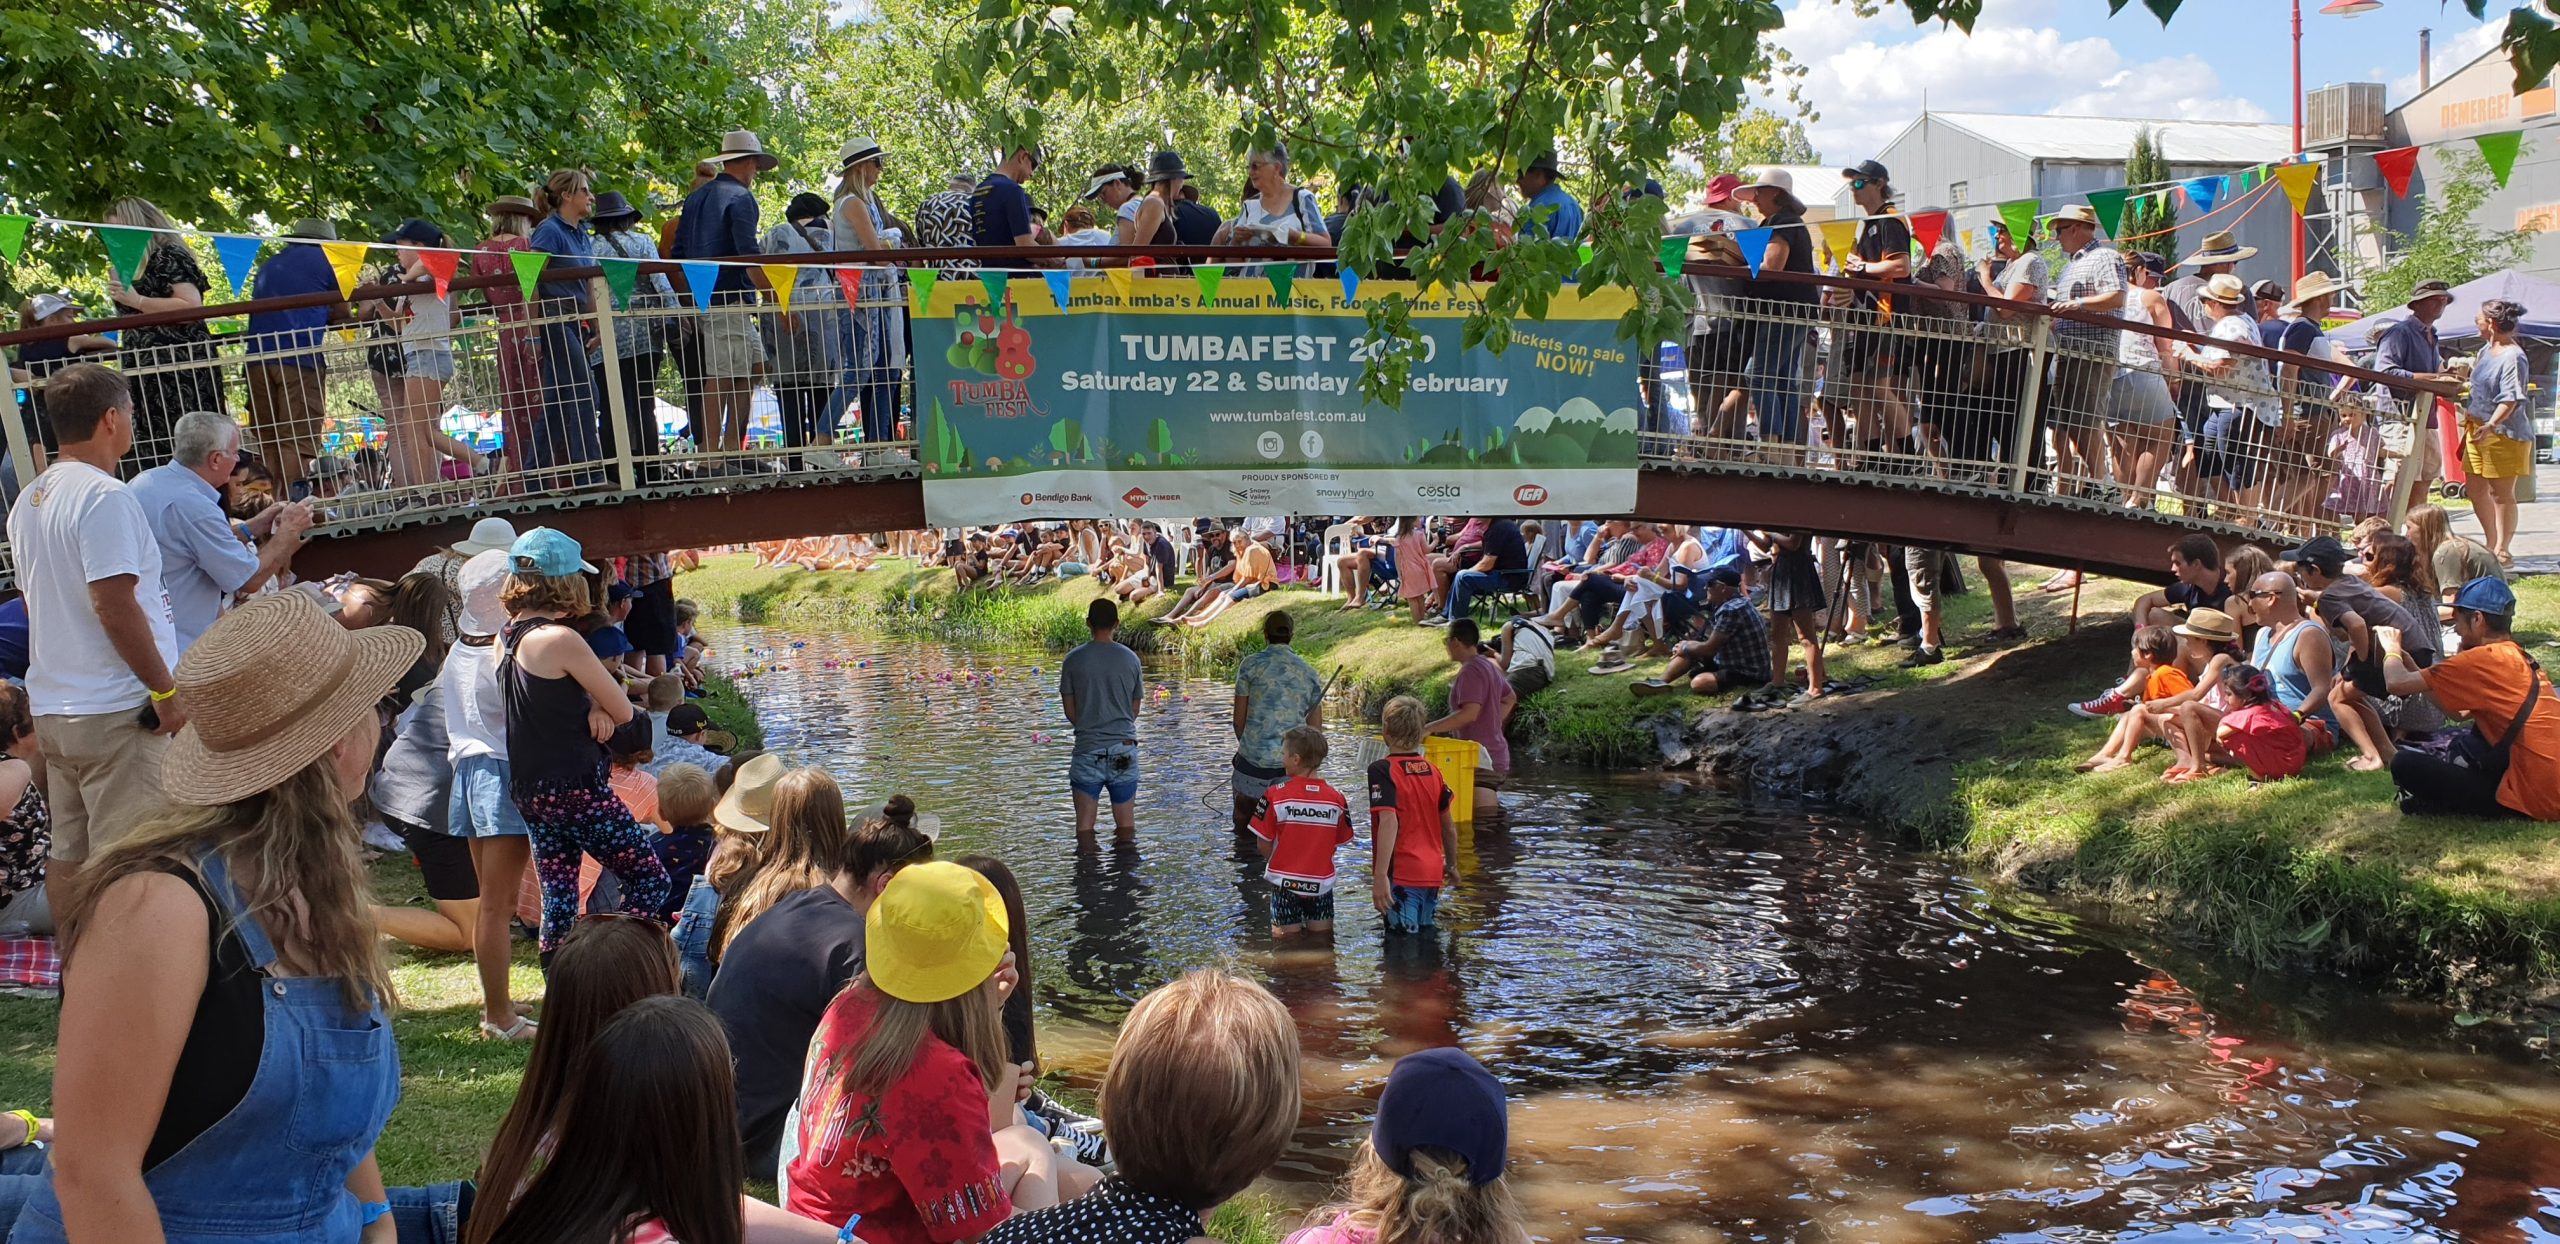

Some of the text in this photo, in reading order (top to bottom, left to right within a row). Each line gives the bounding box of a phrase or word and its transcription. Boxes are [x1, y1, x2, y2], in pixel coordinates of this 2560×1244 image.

[2441, 93, 2510, 129] DEMERGE!
[1197, 294, 1260, 308] Annual
[1266, 295, 1325, 311] Music,
[1120, 334, 1337, 362] TUMBAFEST
[1511, 330, 1626, 364] tickets on sale
[1535, 350, 1595, 378] NOW!
[1061, 370, 1178, 396] Saturday
[1186, 370, 1220, 392] 22
[1227, 372, 1247, 392] &
[1256, 371, 1350, 396] Sunday
[947, 379, 1033, 406] TUMBA
[985, 401, 1028, 418] FEST
[1209, 409, 1367, 423] www.tumbafest.com.au
[1242, 473, 1340, 482] PROUDLY SPONSORED BY
[1035, 493, 1093, 504] Bendigo Bank
[1417, 484, 1461, 498] costa
[1516, 488, 1545, 501] IGA
[1284, 805, 1331, 820] TripADeal
